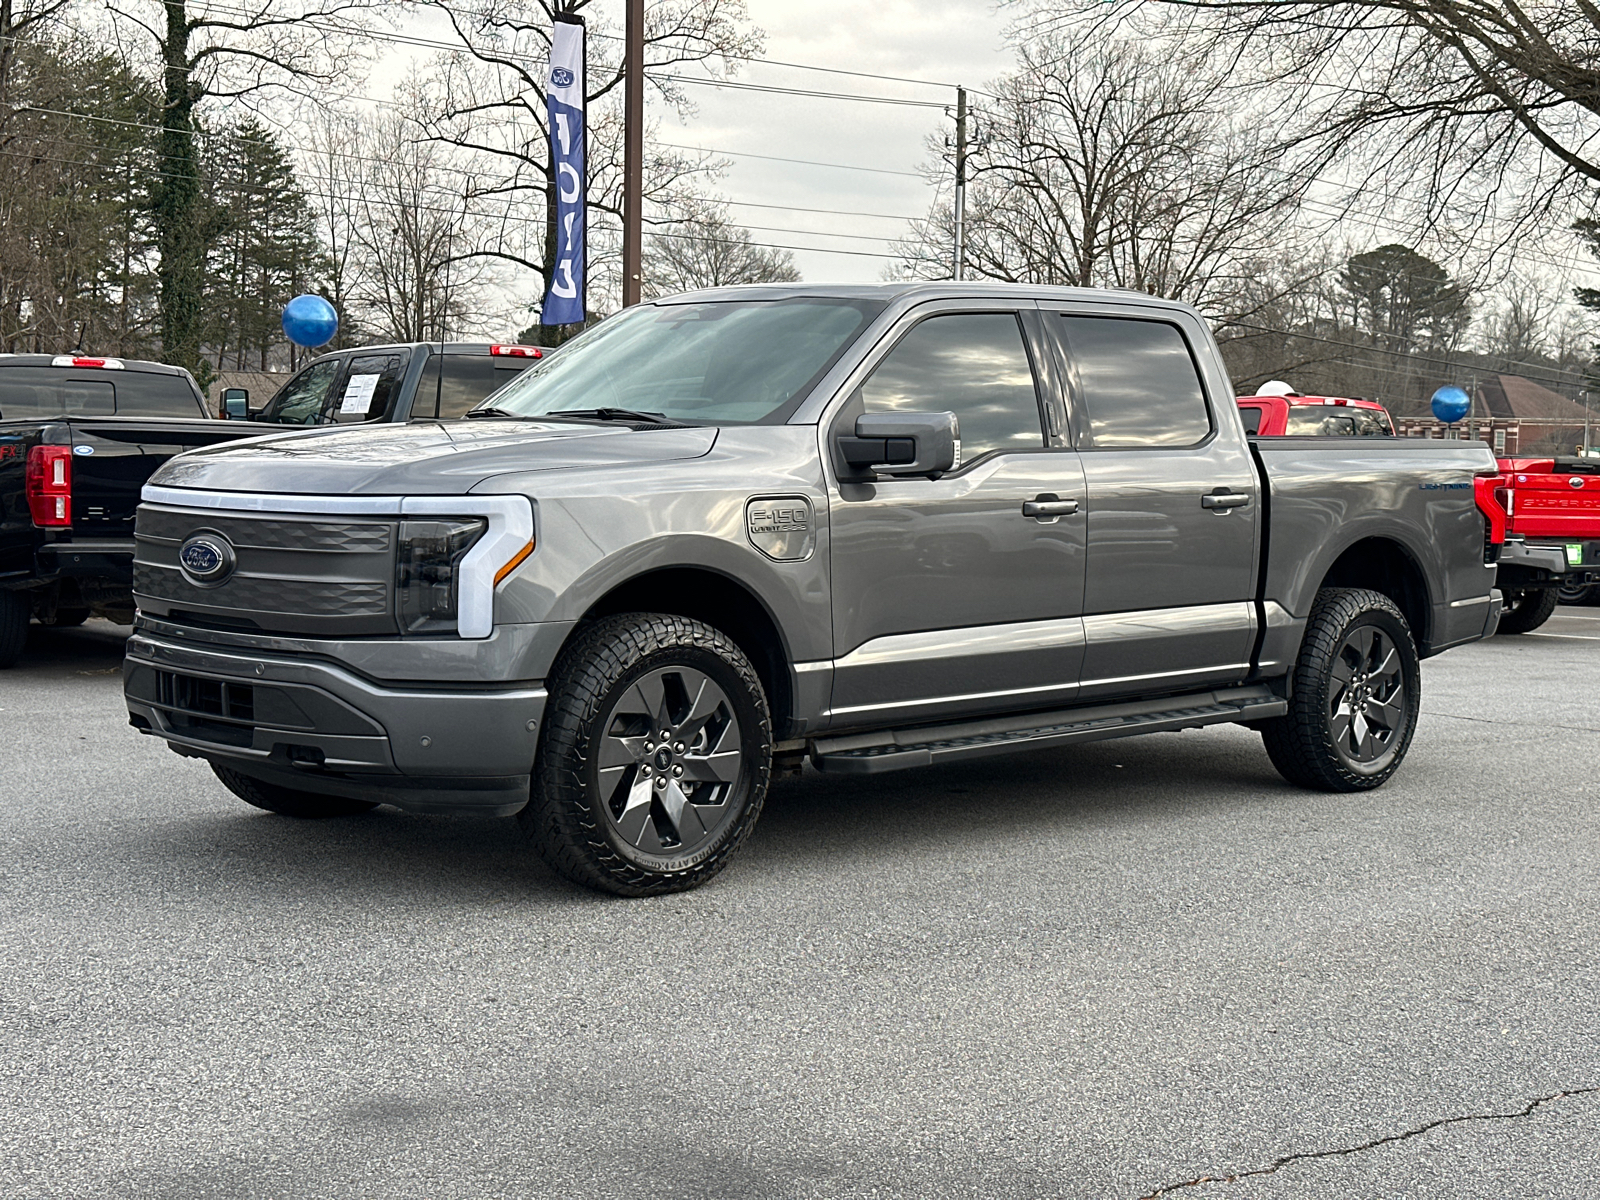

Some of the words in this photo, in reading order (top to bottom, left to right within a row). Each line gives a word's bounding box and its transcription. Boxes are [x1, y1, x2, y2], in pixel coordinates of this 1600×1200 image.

[0, 443, 26, 461] FX4
[1418, 482, 1471, 492] LIGHTNING
[1523, 498, 1579, 507] SUPER
[749, 508, 807, 525] F-150
[186, 547, 211, 568] Ford
